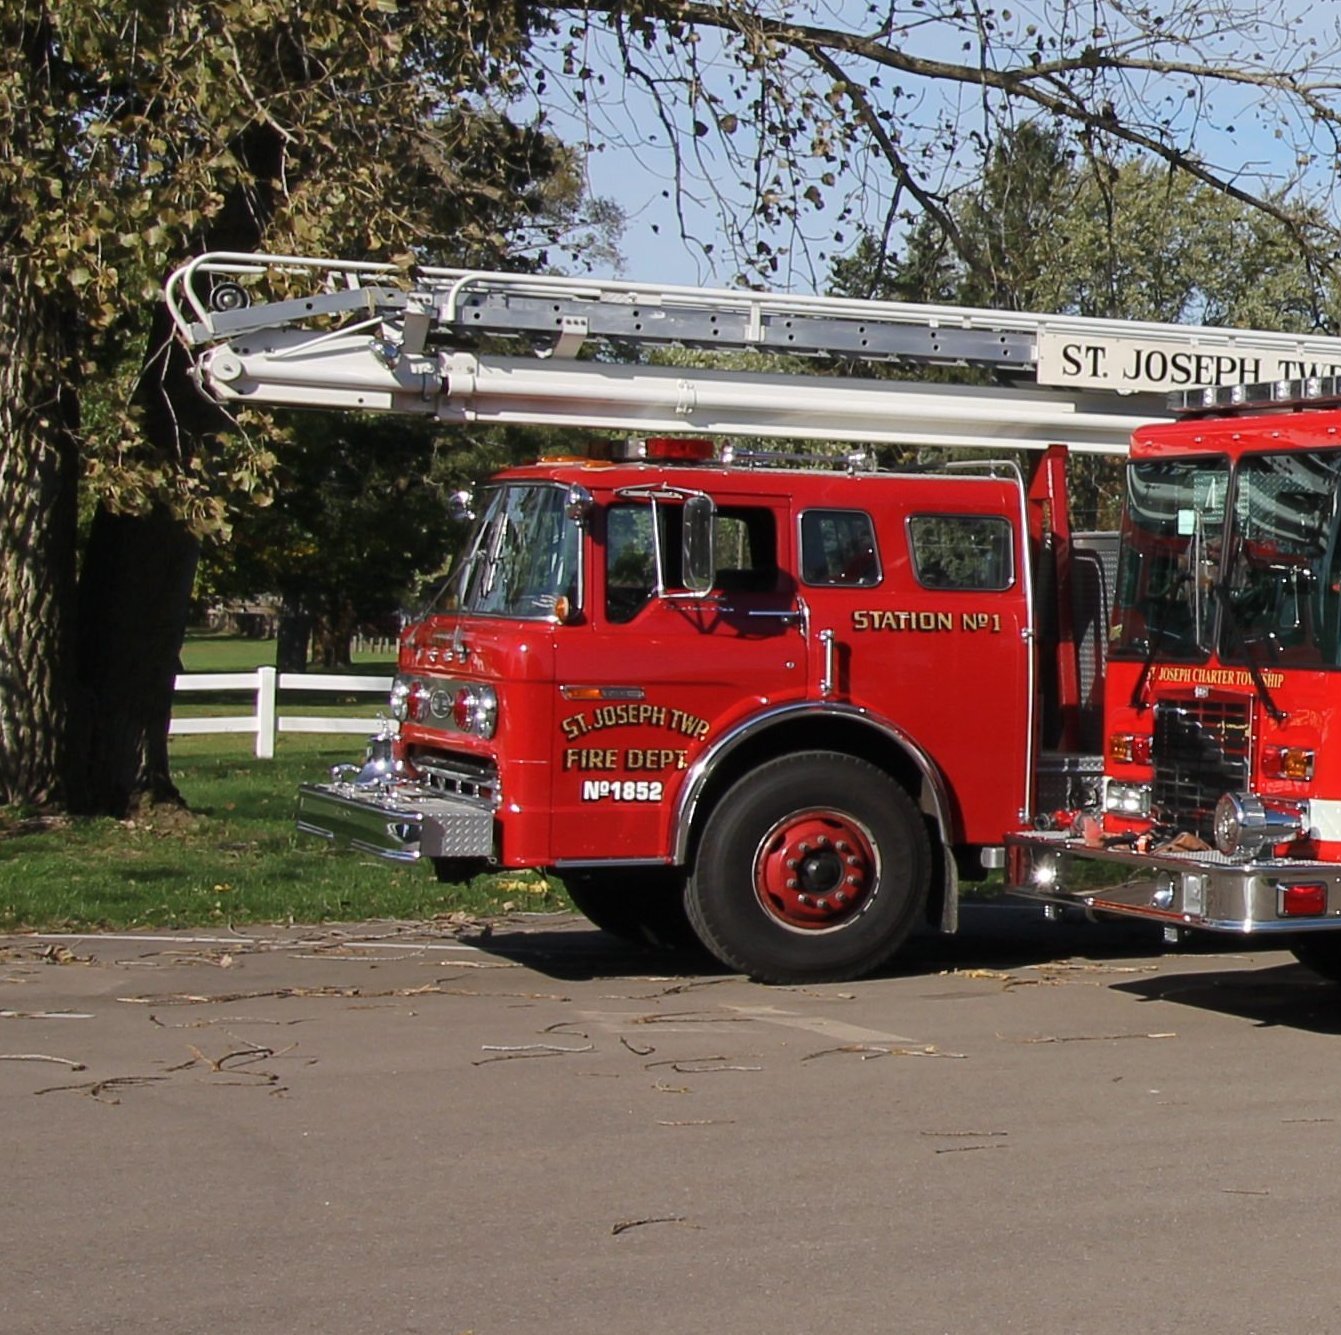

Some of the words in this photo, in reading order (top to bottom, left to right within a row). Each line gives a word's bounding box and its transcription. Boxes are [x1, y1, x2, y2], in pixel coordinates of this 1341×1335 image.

[1062, 344, 1108, 377] ST.
[1123, 349, 1261, 385] JOSEPH
[853, 610, 953, 631] STATION
[1158, 667, 1191, 682] JOSEPH
[1192, 668, 1234, 685] CHARTER
[562, 713, 592, 739] ST.
[594, 704, 665, 728] JOSEPH
[670, 709, 710, 741] TWP.
[565, 749, 618, 769] FIRE
